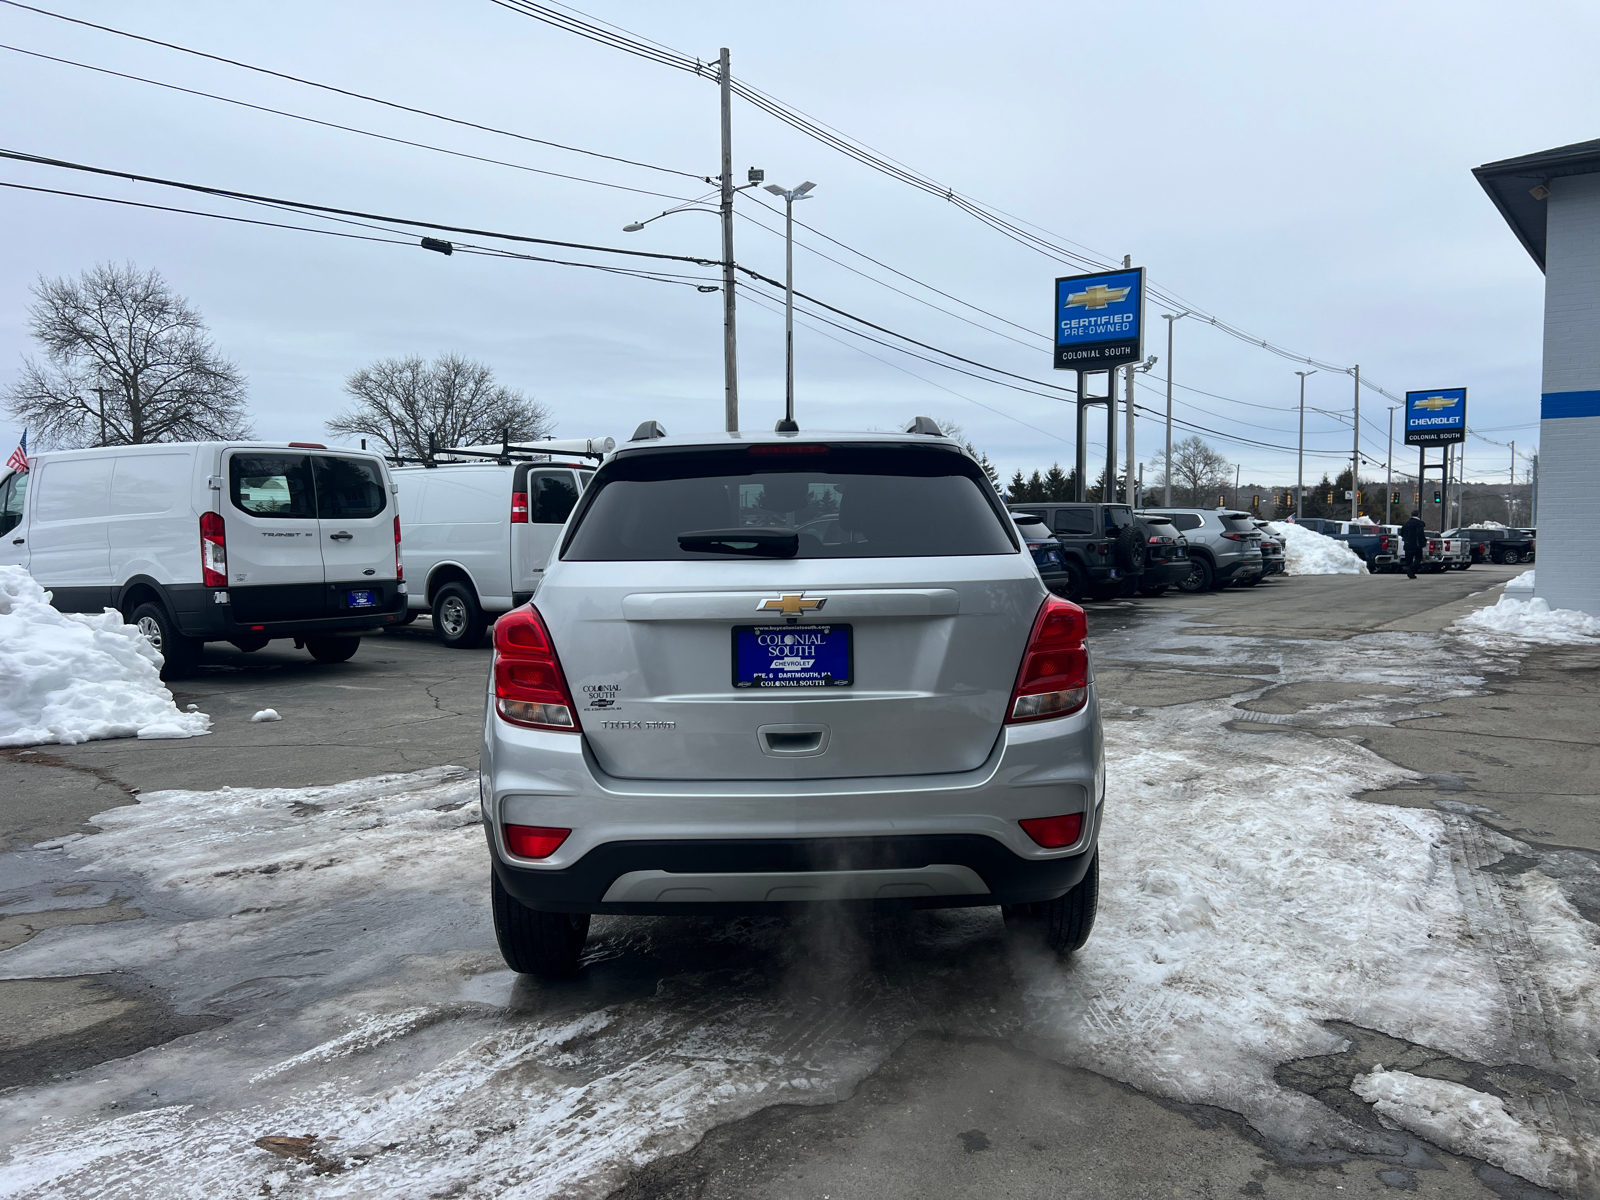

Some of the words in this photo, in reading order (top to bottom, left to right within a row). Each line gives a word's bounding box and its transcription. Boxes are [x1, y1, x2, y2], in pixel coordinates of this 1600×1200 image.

[1061, 313, 1133, 329] CERTIFIED
[1064, 322, 1130, 337] PRE-OWNED
[1062, 350, 1100, 360] COLONIAL
[1104, 346, 1131, 356] SOUTH
[1410, 416, 1460, 426] CHEVROLET
[758, 634, 826, 646] COLONIAL
[768, 646, 816, 656] SOUTH
[582, 684, 622, 692] COLONIAL
[600, 720, 642, 729] TRAX
[646, 721, 676, 729] AWD
